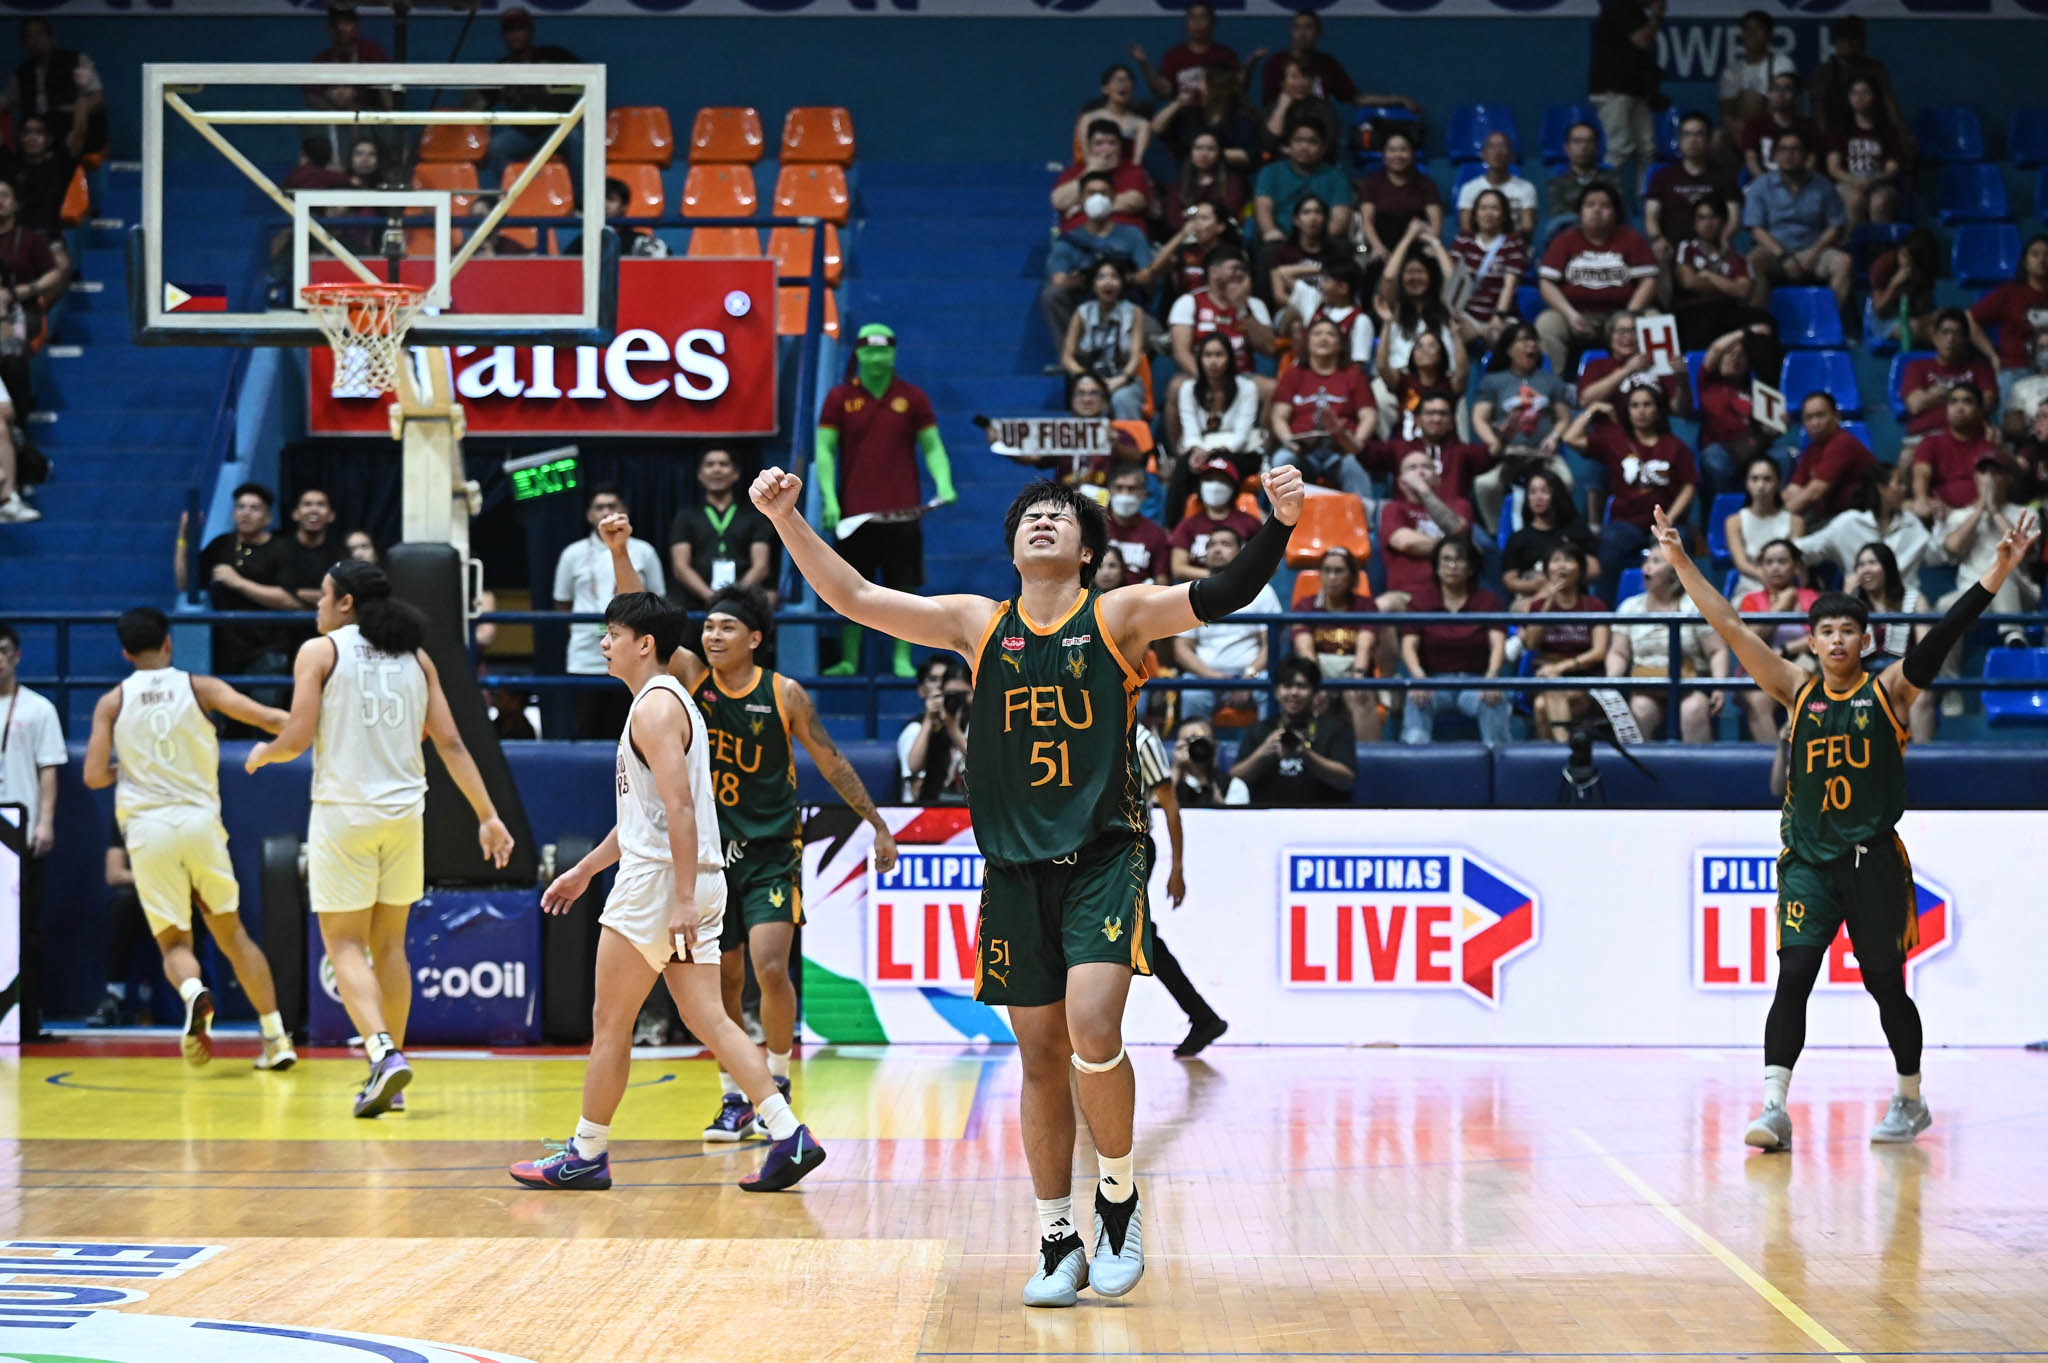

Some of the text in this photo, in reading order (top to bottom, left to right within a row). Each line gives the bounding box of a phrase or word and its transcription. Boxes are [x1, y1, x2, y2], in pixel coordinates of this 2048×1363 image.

[1643, 326, 1675, 362] H
[1758, 389, 1781, 420] T
[1002, 422, 1101, 449] UP FIGHT
[513, 458, 577, 500] EXIT
[356, 662, 405, 729] 55
[1003, 685, 1094, 733] FEU
[1030, 740, 1073, 787] 51
[1807, 733, 1870, 774] FEU
[1822, 775, 1852, 812] 10
[1296, 859, 1442, 889] PILIPINAS
[1786, 901, 1805, 919] 10
[878, 904, 980, 980] LIV
[989, 939, 1011, 966] 51
[1290, 906, 1452, 982] LIVE
